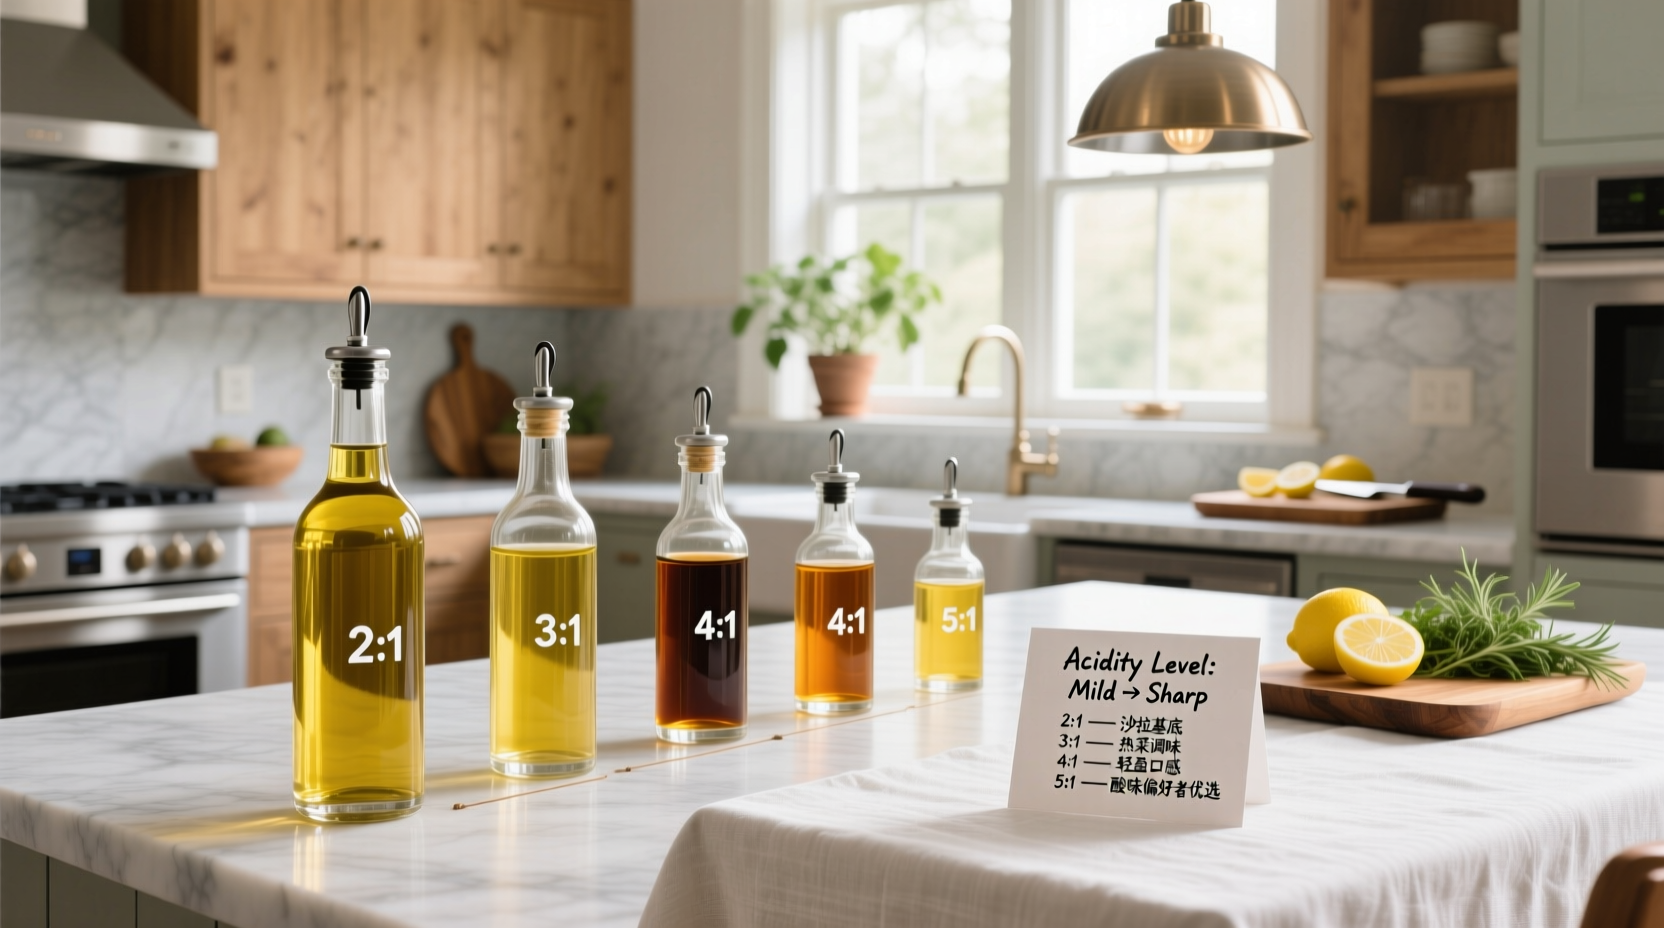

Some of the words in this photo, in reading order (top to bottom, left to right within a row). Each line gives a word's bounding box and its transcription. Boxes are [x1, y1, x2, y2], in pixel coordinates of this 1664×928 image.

[534, 613, 582, 648] 3:1
[694, 610, 736, 641] 4:1
[827, 606, 866, 636] 4:1
[941, 606, 976, 633] 5:1
[348, 625, 402, 664] 2:1
[1063, 646, 1143, 682] Acidity
[1151, 650, 1216, 676] Level:
[1067, 678, 1117, 701] Mild
[1145, 681, 1208, 712] Sharp
[1060, 713, 1083, 728] 2:1
[1120, 714, 1183, 735] 沙拉基底
[1058, 734, 1081, 748] 3:1
[1056, 754, 1078, 769] 4:1
[1053, 774, 1076, 789] 5:1
